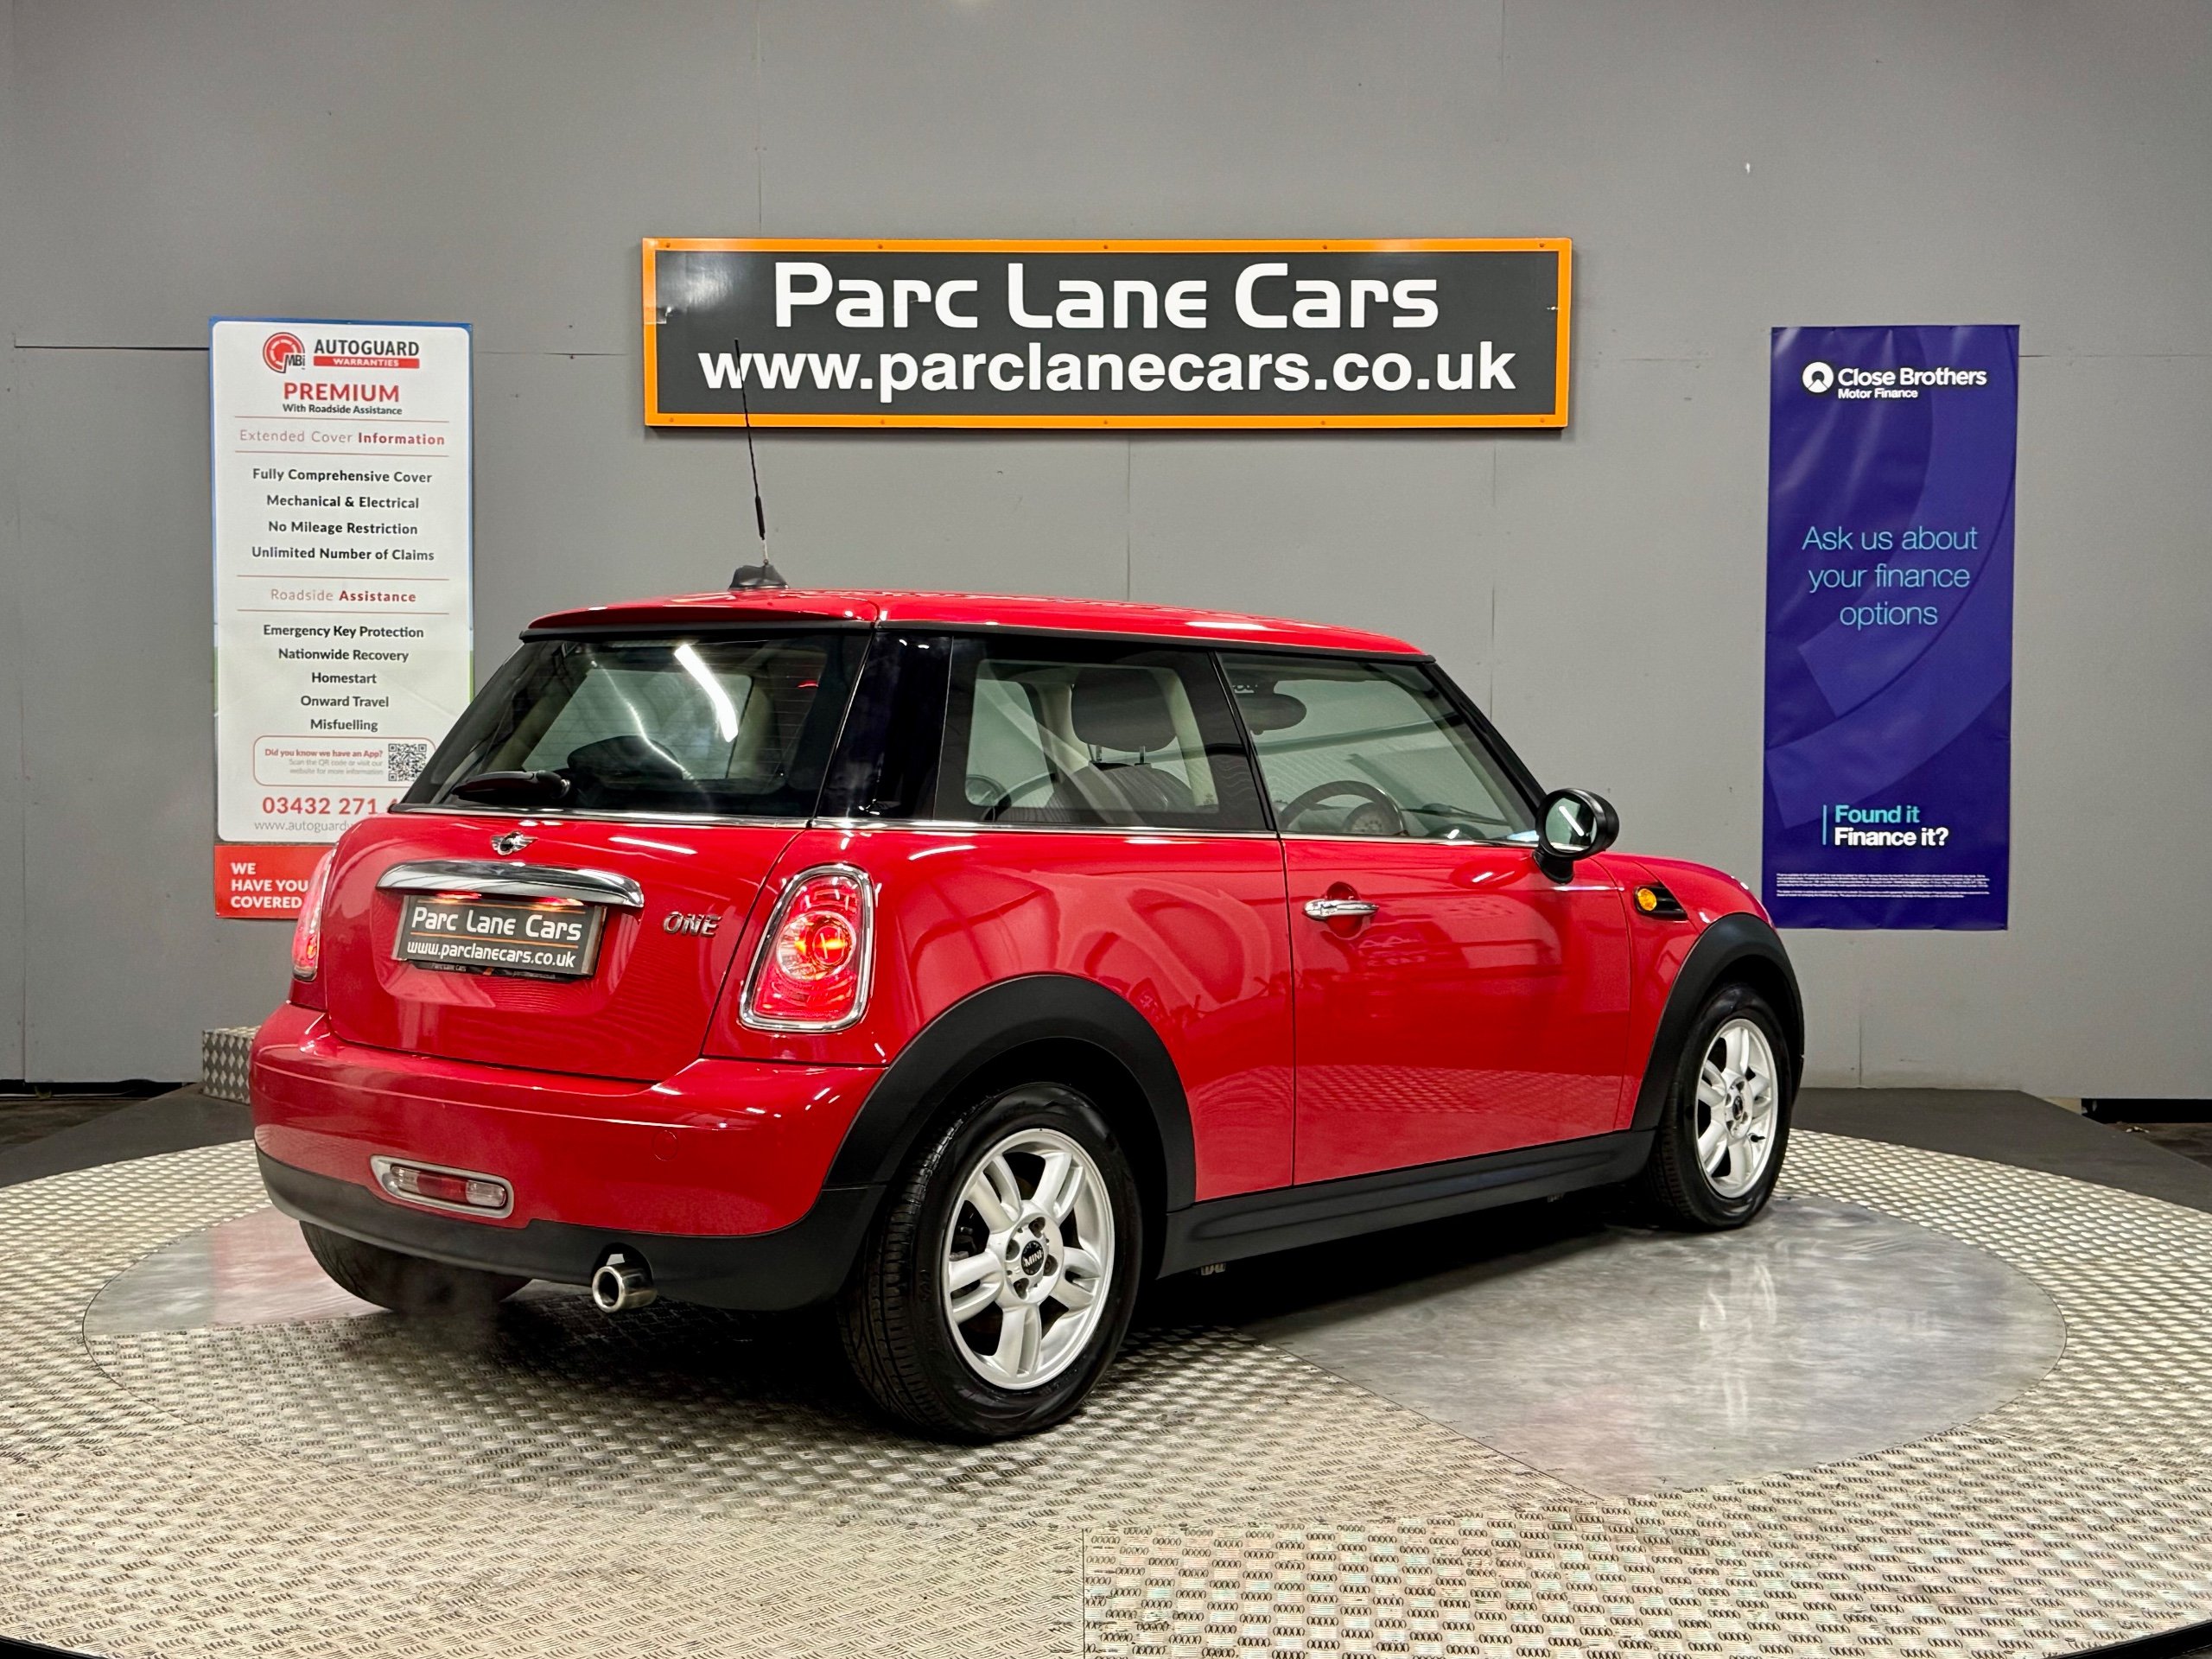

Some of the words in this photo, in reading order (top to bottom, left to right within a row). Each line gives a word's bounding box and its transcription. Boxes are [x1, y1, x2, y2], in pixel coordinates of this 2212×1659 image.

[775, 262, 977, 328] Parc
[1007, 263, 1206, 328] Lane
[1235, 263, 1439, 328] Cars
[314, 339, 420, 357] AUTOGUARD
[285, 354, 306, 366] MBi
[333, 358, 399, 367] WARRANTIES
[698, 341, 1516, 403] www.parclanecars.co.uk
[1838, 368, 1896, 386] Close
[1900, 367, 1986, 385] Brothers
[283, 383, 399, 402] PREMIUM
[1838, 388, 1872, 399] Motor
[1874, 388, 1918, 398] Finance
[283, 404, 306, 413] With
[308, 404, 351, 414] Roadside
[353, 405, 403, 415] Assistance
[239, 429, 305, 442] Extended
[311, 431, 352, 443] Cover
[358, 432, 445, 445] Information
[252, 468, 284, 481] Fully
[288, 469, 390, 483] Comprehensive
[393, 472, 432, 483] Cover
[267, 495, 340, 507] Mechanical
[345, 497, 354, 507] &
[359, 497, 419, 509] Electrical
[268, 521, 287, 532] No
[291, 522, 342, 535] Mileage
[346, 523, 418, 535] Restriction
[1802, 525, 1853, 550] Ask
[1861, 531, 1892, 550] us
[1902, 526, 1978, 550] about
[251, 547, 315, 559] Unlimited
[320, 548, 372, 560] Number
[375, 549, 389, 560] of
[392, 549, 435, 561] Claims
[1808, 569, 1867, 593] your
[1875, 563, 1970, 588] finance
[270, 588, 334, 601] Roadside
[339, 590, 416, 602] Assistance
[1840, 601, 1938, 630] options
[264, 625, 330, 639] Emergency
[334, 626, 357, 639] Key
[359, 626, 424, 638] Protection
[278, 648, 349, 660] Nationwide
[353, 650, 409, 663] Recovery
[311, 672, 377, 684] Homestart
[301, 696, 349, 707] Onward
[352, 696, 389, 708] Travel
[310, 719, 378, 733] Misfuelling
[363, 750, 383, 759] App?
[263, 797, 331, 815] 03432
[339, 798, 378, 815] 271
[1835, 804, 1901, 823] Found
[1906, 805, 1920, 823] it
[1834, 827, 1916, 846] Finance
[1922, 827, 1949, 845] it?
[232, 863, 256, 874] WE
[232, 880, 272, 892] HAVE
[275, 880, 308, 892] YOU
[231, 896, 302, 908] COVERED
[410, 906, 458, 931] Parc
[466, 909, 516, 936] Lane
[524, 914, 582, 942] Cars
[663, 911, 724, 938] ONE
[407, 940, 576, 969] www.parclanecars.co.uk
[1022, 1249, 1043, 1268] MINI
